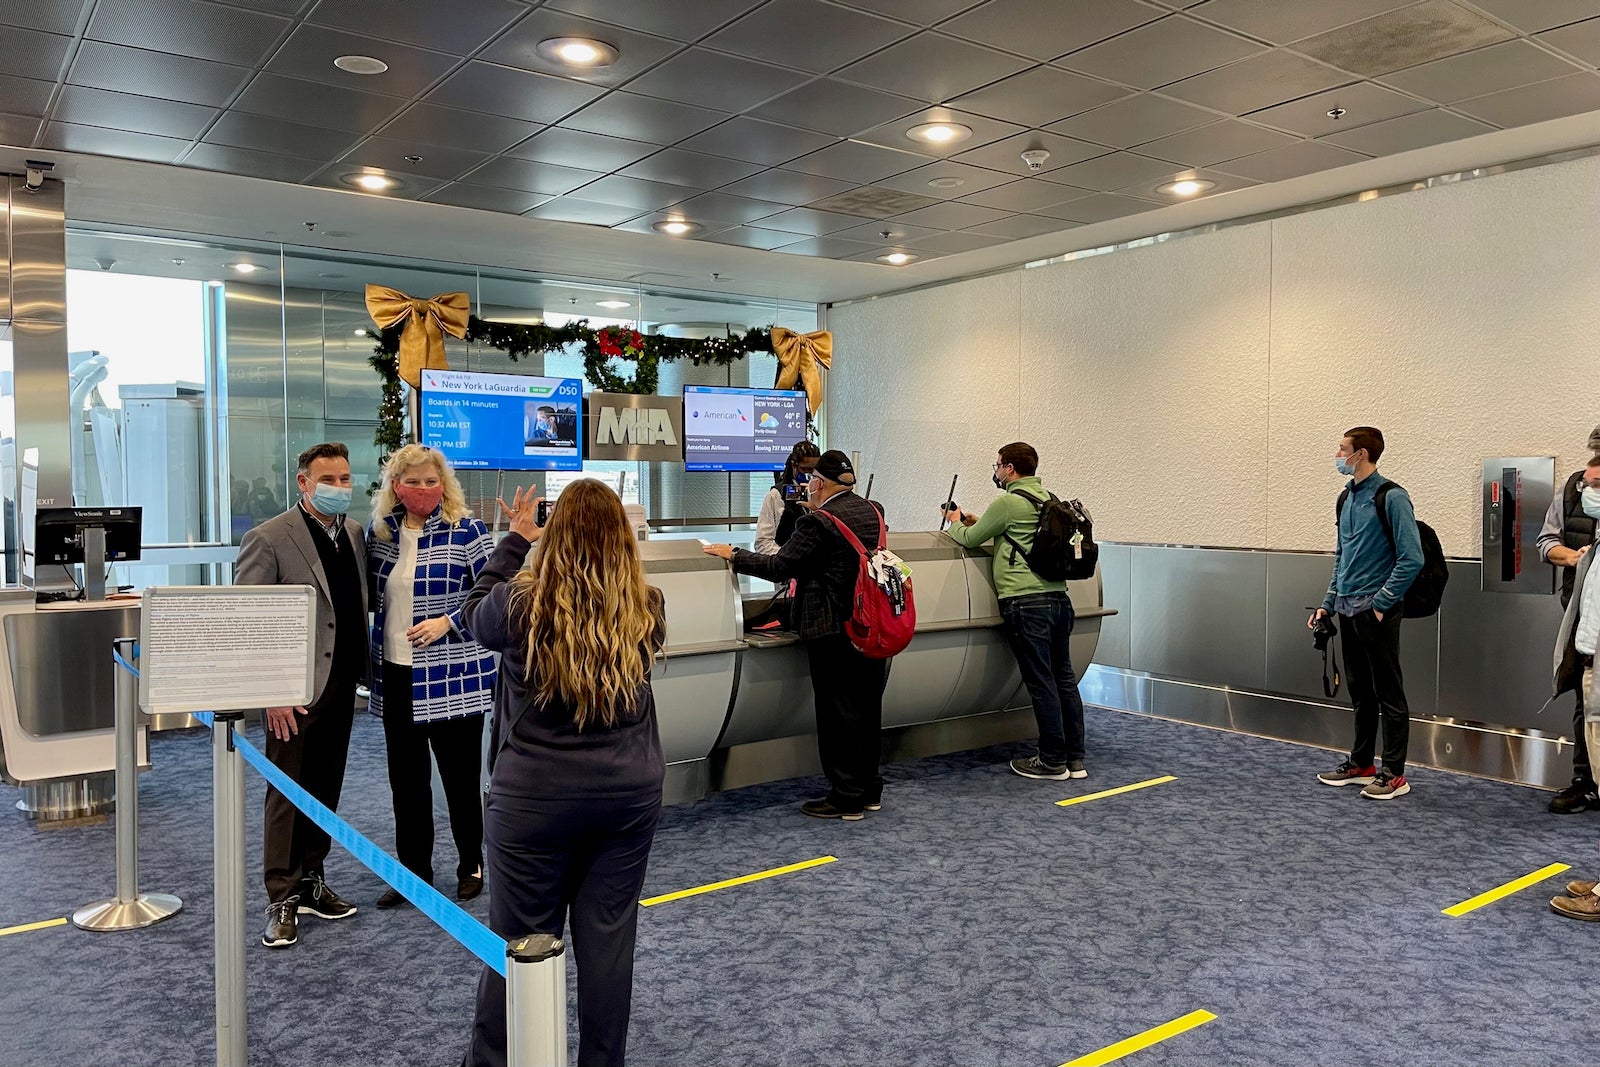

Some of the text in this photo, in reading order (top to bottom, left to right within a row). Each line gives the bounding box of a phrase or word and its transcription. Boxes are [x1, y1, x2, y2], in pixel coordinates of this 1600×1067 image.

[442, 380, 526, 393] New York LaGuardia
[559, 386, 578, 396] D50
[428, 398, 452, 406] Boards
[704, 411, 737, 419] American
[596, 406, 678, 445] MIA
